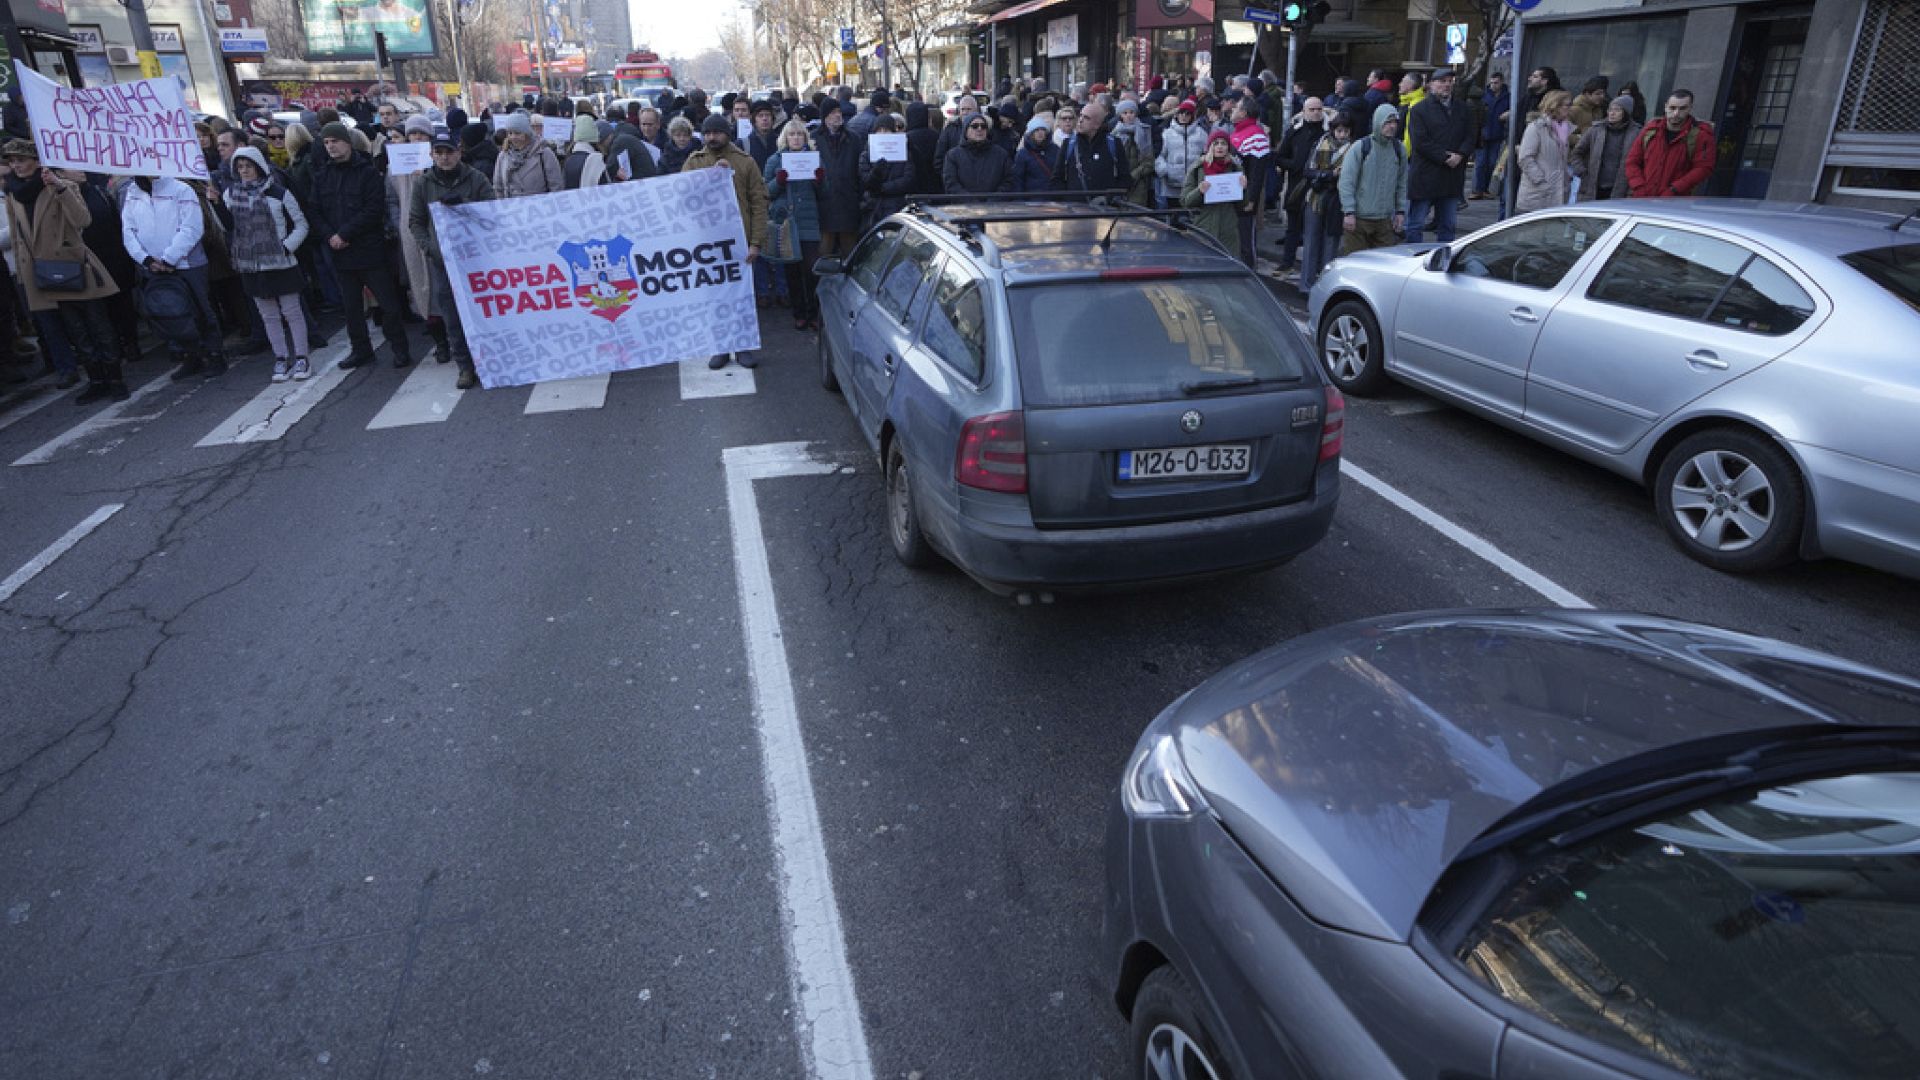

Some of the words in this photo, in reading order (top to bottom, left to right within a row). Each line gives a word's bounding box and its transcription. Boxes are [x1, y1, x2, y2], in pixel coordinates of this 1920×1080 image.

[572, 190, 653, 229] ТРАЈЕ
[664, 183, 733, 221] МОСТ
[634, 238, 736, 275] МОСТ
[468, 263, 567, 293] БОРБА
[641, 261, 742, 296] ОСТАЈЕ
[474, 286, 573, 318] ТРАЈЕ
[643, 310, 709, 345] МОСТ
